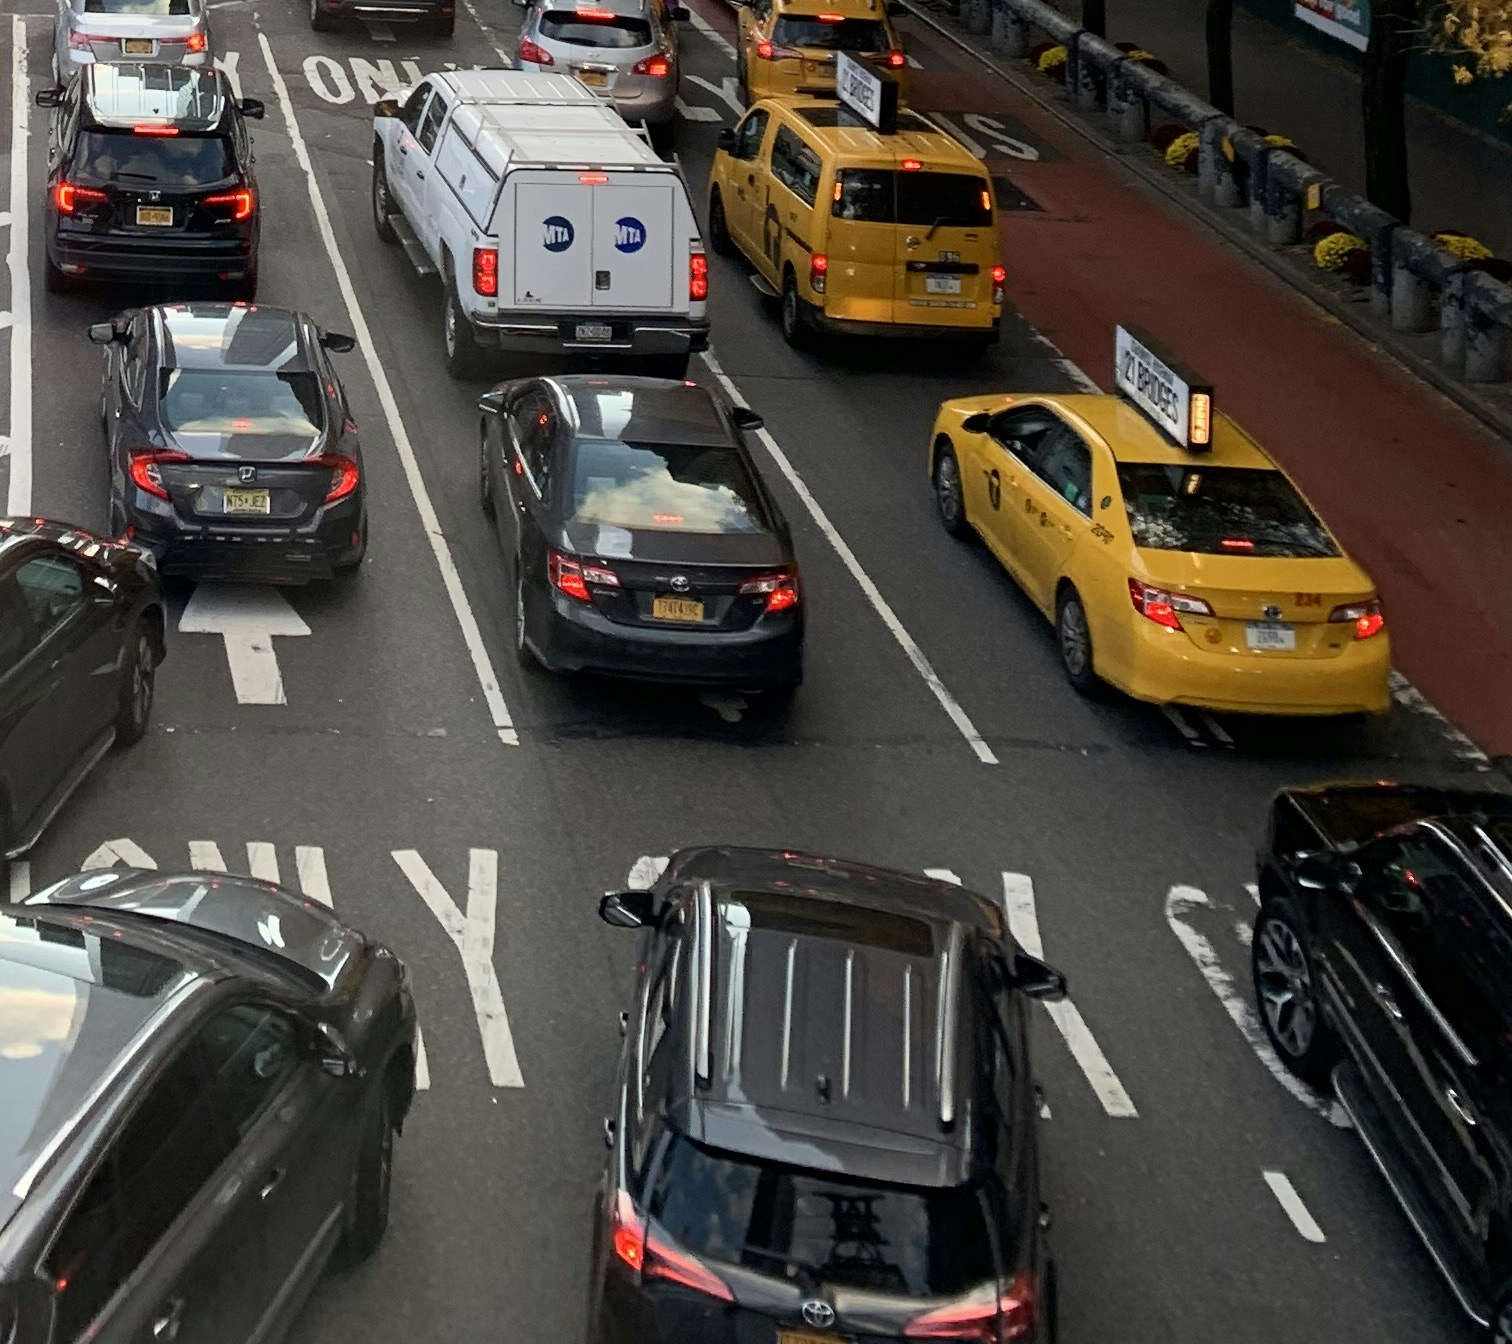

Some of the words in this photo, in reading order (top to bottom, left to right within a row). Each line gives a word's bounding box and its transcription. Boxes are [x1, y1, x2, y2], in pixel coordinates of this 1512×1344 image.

[543, 223, 570, 245] MTA
[615, 223, 641, 245] MTA
[1137, 360, 1180, 425] BRIDGES
